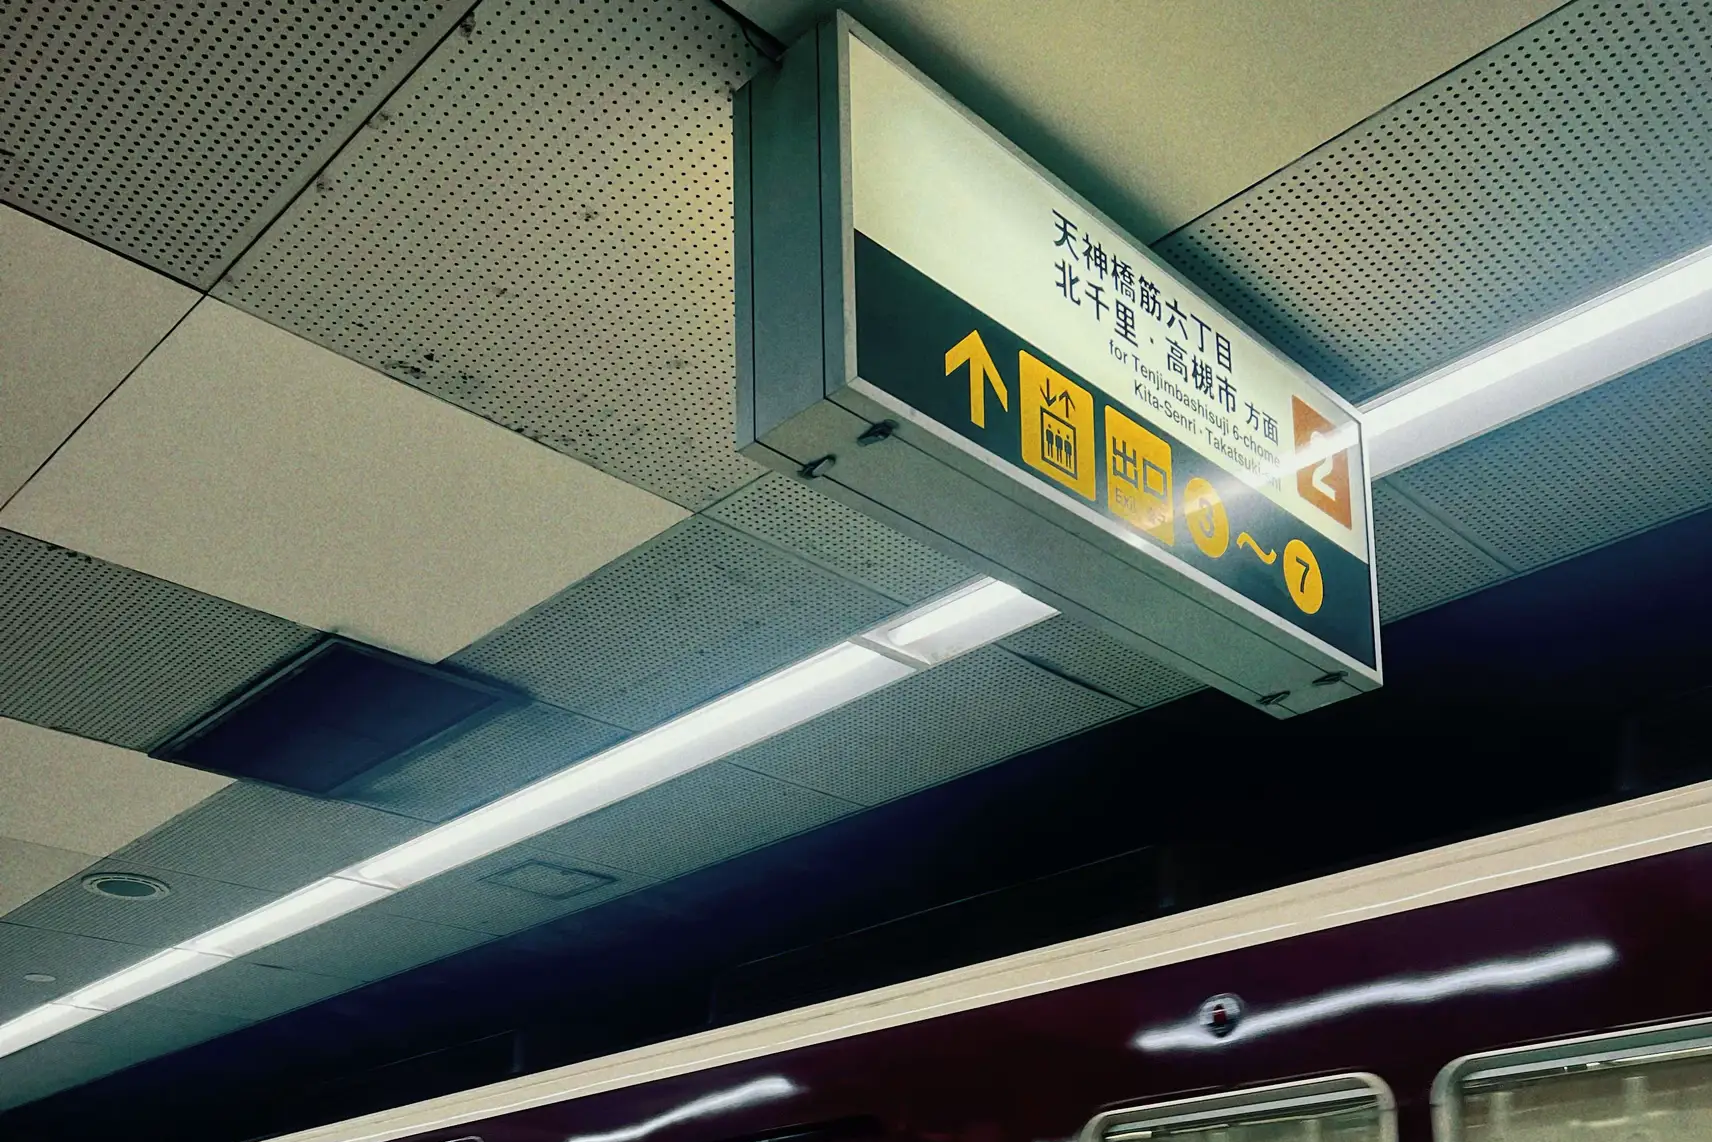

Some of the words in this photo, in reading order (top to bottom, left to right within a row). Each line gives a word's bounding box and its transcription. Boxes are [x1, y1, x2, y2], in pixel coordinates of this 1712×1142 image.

[1052, 208, 1233, 373] 天神橋筋六丁目
[1109, 339, 1128, 364] for
[1132, 354, 1230, 434] Tenjimbashisuji
[1232, 425, 1281, 468] 6-chome
[1134, 379, 1196, 434] Kita-Senri
[1244, 401, 1279, 446] 方面
[1112, 436, 1168, 500] 出口
[1295, 557, 1310, 594] 7
